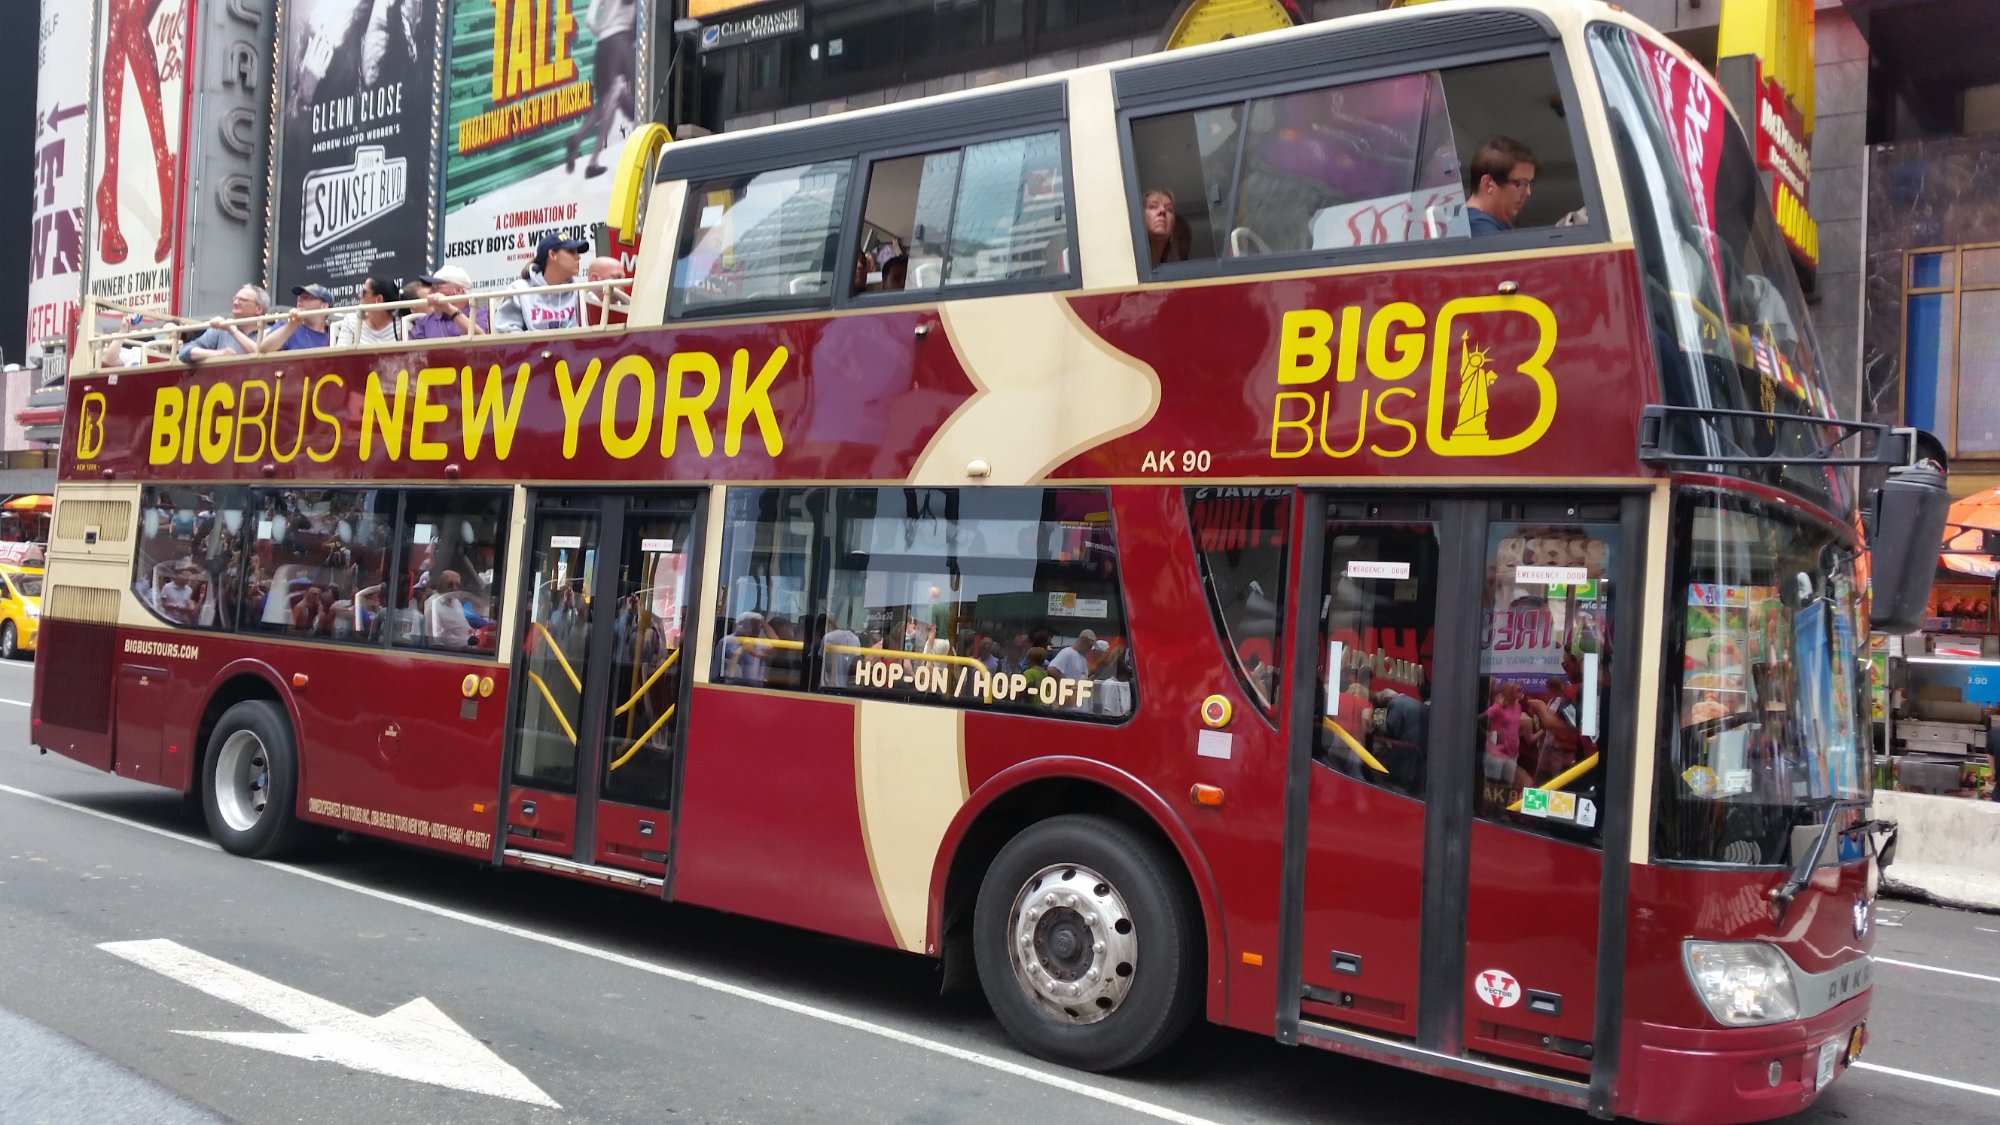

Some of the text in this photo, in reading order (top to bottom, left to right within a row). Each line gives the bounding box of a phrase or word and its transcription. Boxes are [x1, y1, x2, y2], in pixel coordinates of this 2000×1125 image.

[491, 0, 576, 103] TALE
[312, 82, 402, 134] GLENN CLOSE
[458, 79, 592, 154] BROADWAY'S NEW HIT MUSICAL
[312, 123, 400, 154] ANDREW LLOYD WEBBER'S
[313, 171, 376, 238] SUNSET
[503, 207, 564, 230] COMBINATION
[566, 203, 578, 220] OF
[445, 237, 484, 259] JERSEY
[486, 234, 515, 253] BOYS
[517, 232, 525, 249] &
[620, 251, 637, 273] M
[92, 274, 126, 298] WINNER!
[127, 273, 133, 294] 6
[135, 269, 157, 293] TONY
[129, 294, 151, 307] BEST
[1278, 302, 1425, 385] BIG
[360, 365, 531, 461] NEW
[555, 346, 789, 459] YORK
[1270, 387, 1417, 459] BUS
[1141, 449, 1211, 473] AK 90
[1348, 565, 1386, 574] EMERGENCY
[1517, 571, 1559, 580] EMERGENCY
[124, 639, 199, 660] BIGBUSTOURS.COM
[855, 660, 1094, 708] HOP-ON / HOP-OFF
[1584, 802, 1591, 814] 4
[1484, 986, 1512, 999] VECTOR
